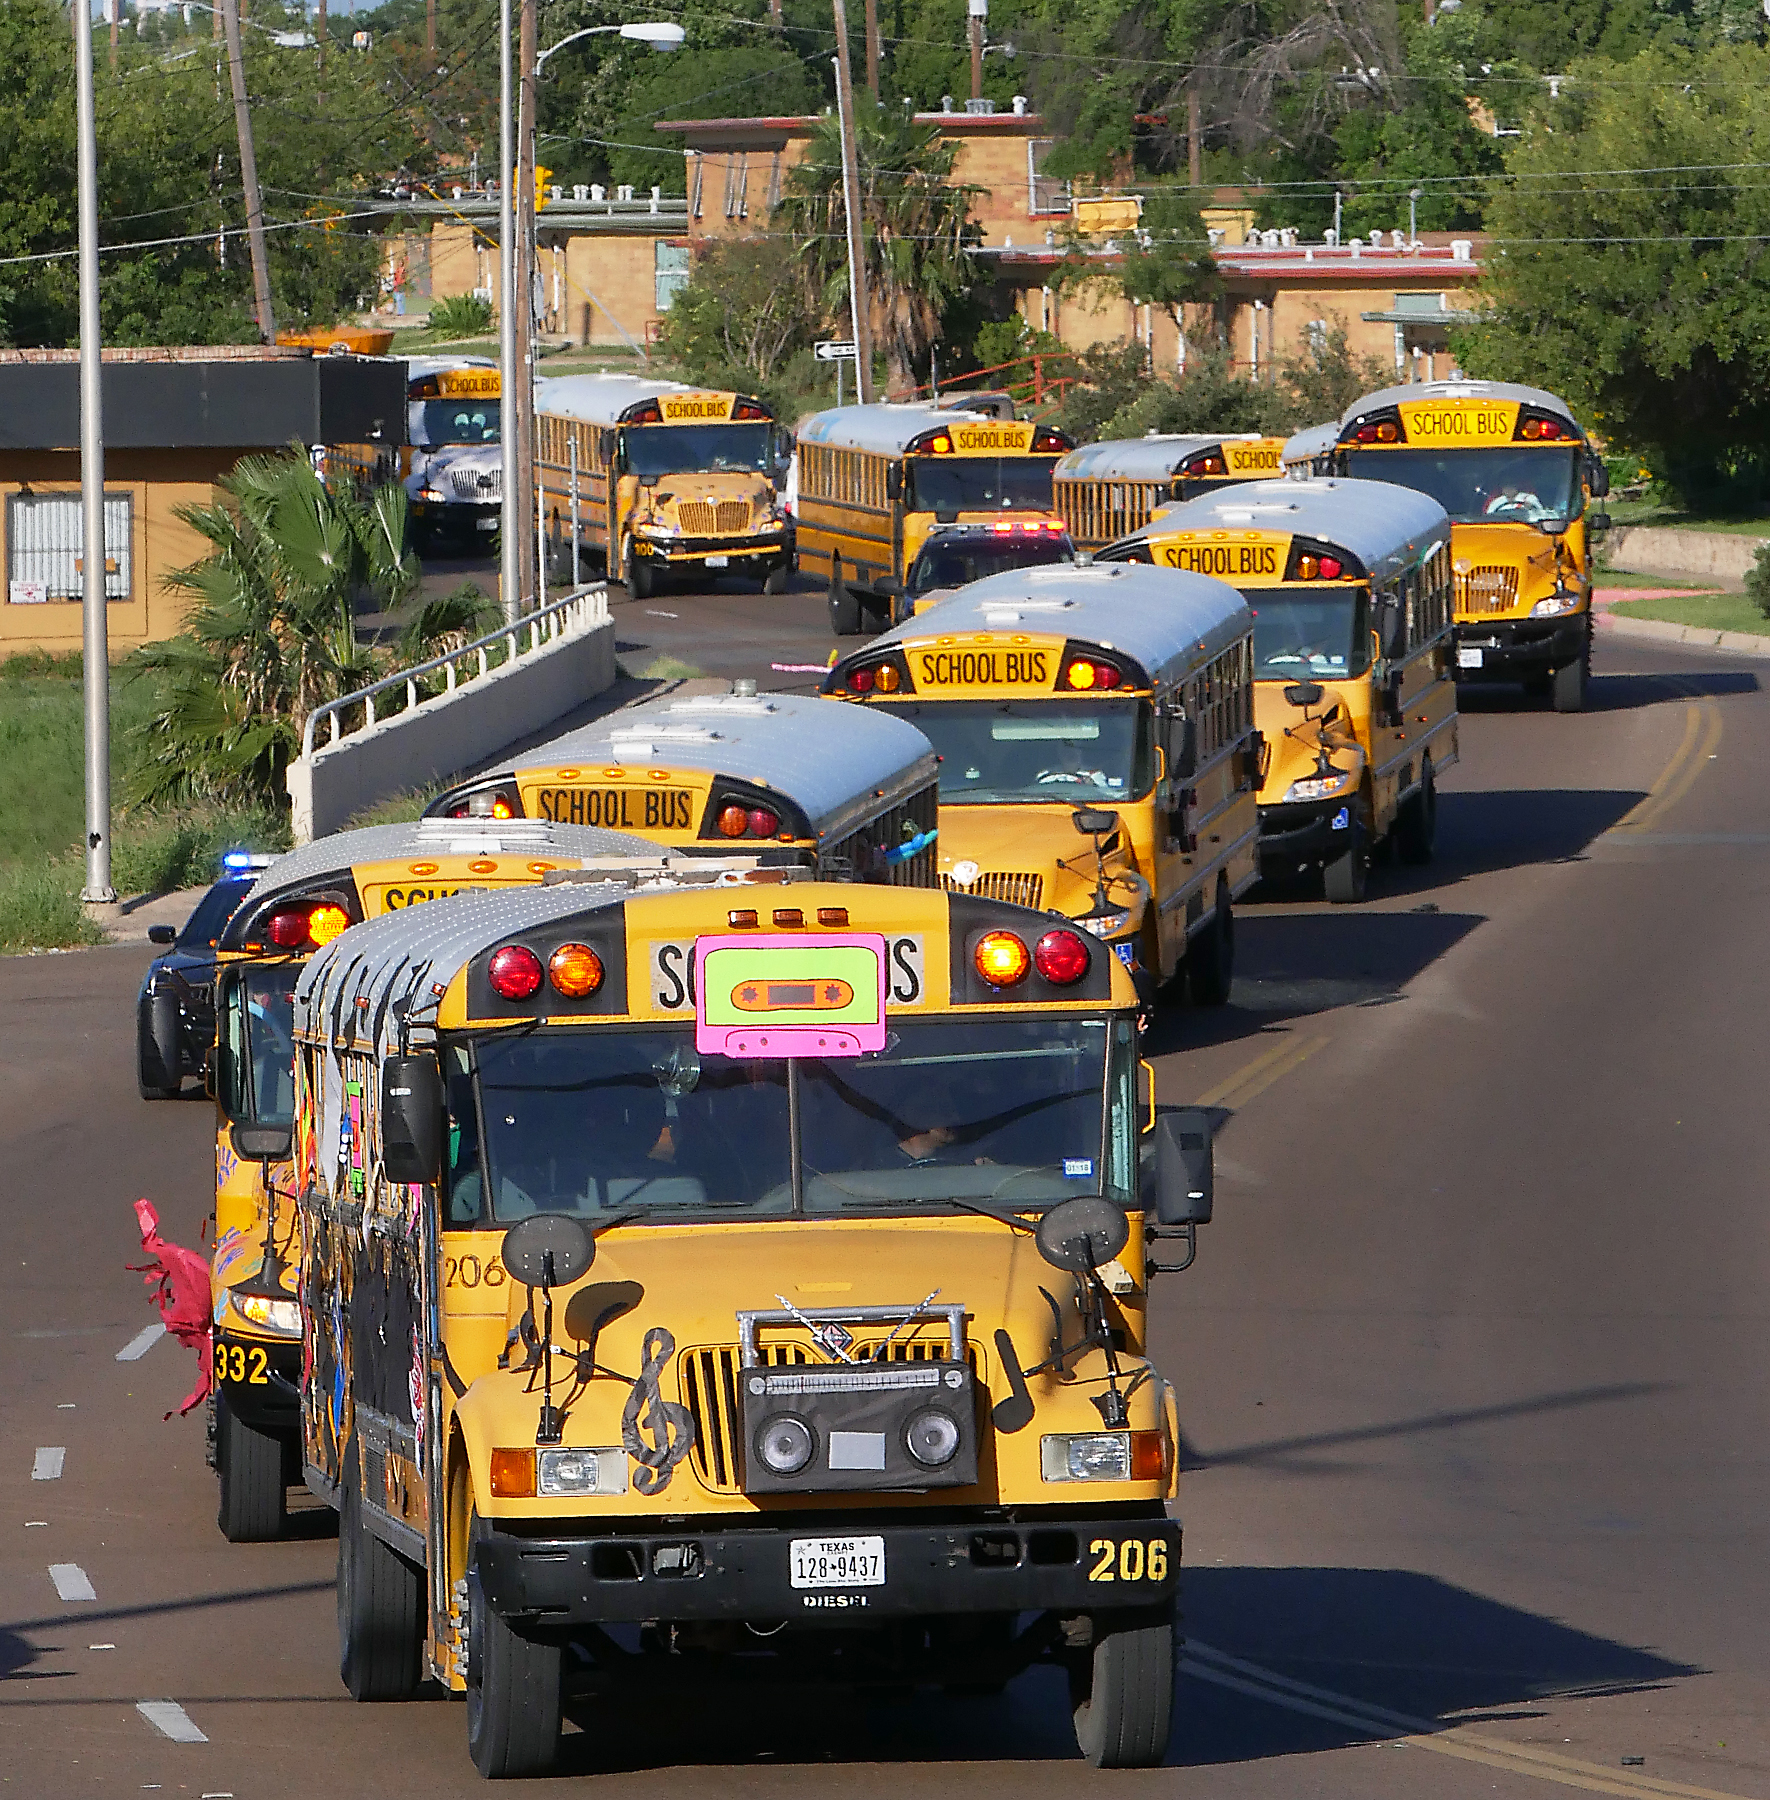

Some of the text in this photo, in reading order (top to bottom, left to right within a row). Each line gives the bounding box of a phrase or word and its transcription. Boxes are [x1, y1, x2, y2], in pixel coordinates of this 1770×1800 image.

[445, 377, 500, 393] SCHOOL BUS
[666, 402, 726, 418] SCHOOL BUS
[1413, 413, 1507, 435] SCHOOL BUS
[959, 432, 1025, 449] SCHOOL BUS
[1234, 451, 1280, 469] SCHOOL
[1166, 547, 1276, 574] SCHOOL BUS
[922, 653, 1047, 684] SCHOOL BUS
[540, 789, 690, 828] SCHOOL BUS
[446, 1254, 505, 1289] 206
[216, 1345, 268, 1384] 332
[819, 1542, 855, 1552] TEXAS
[1088, 1539, 1168, 1582] 206
